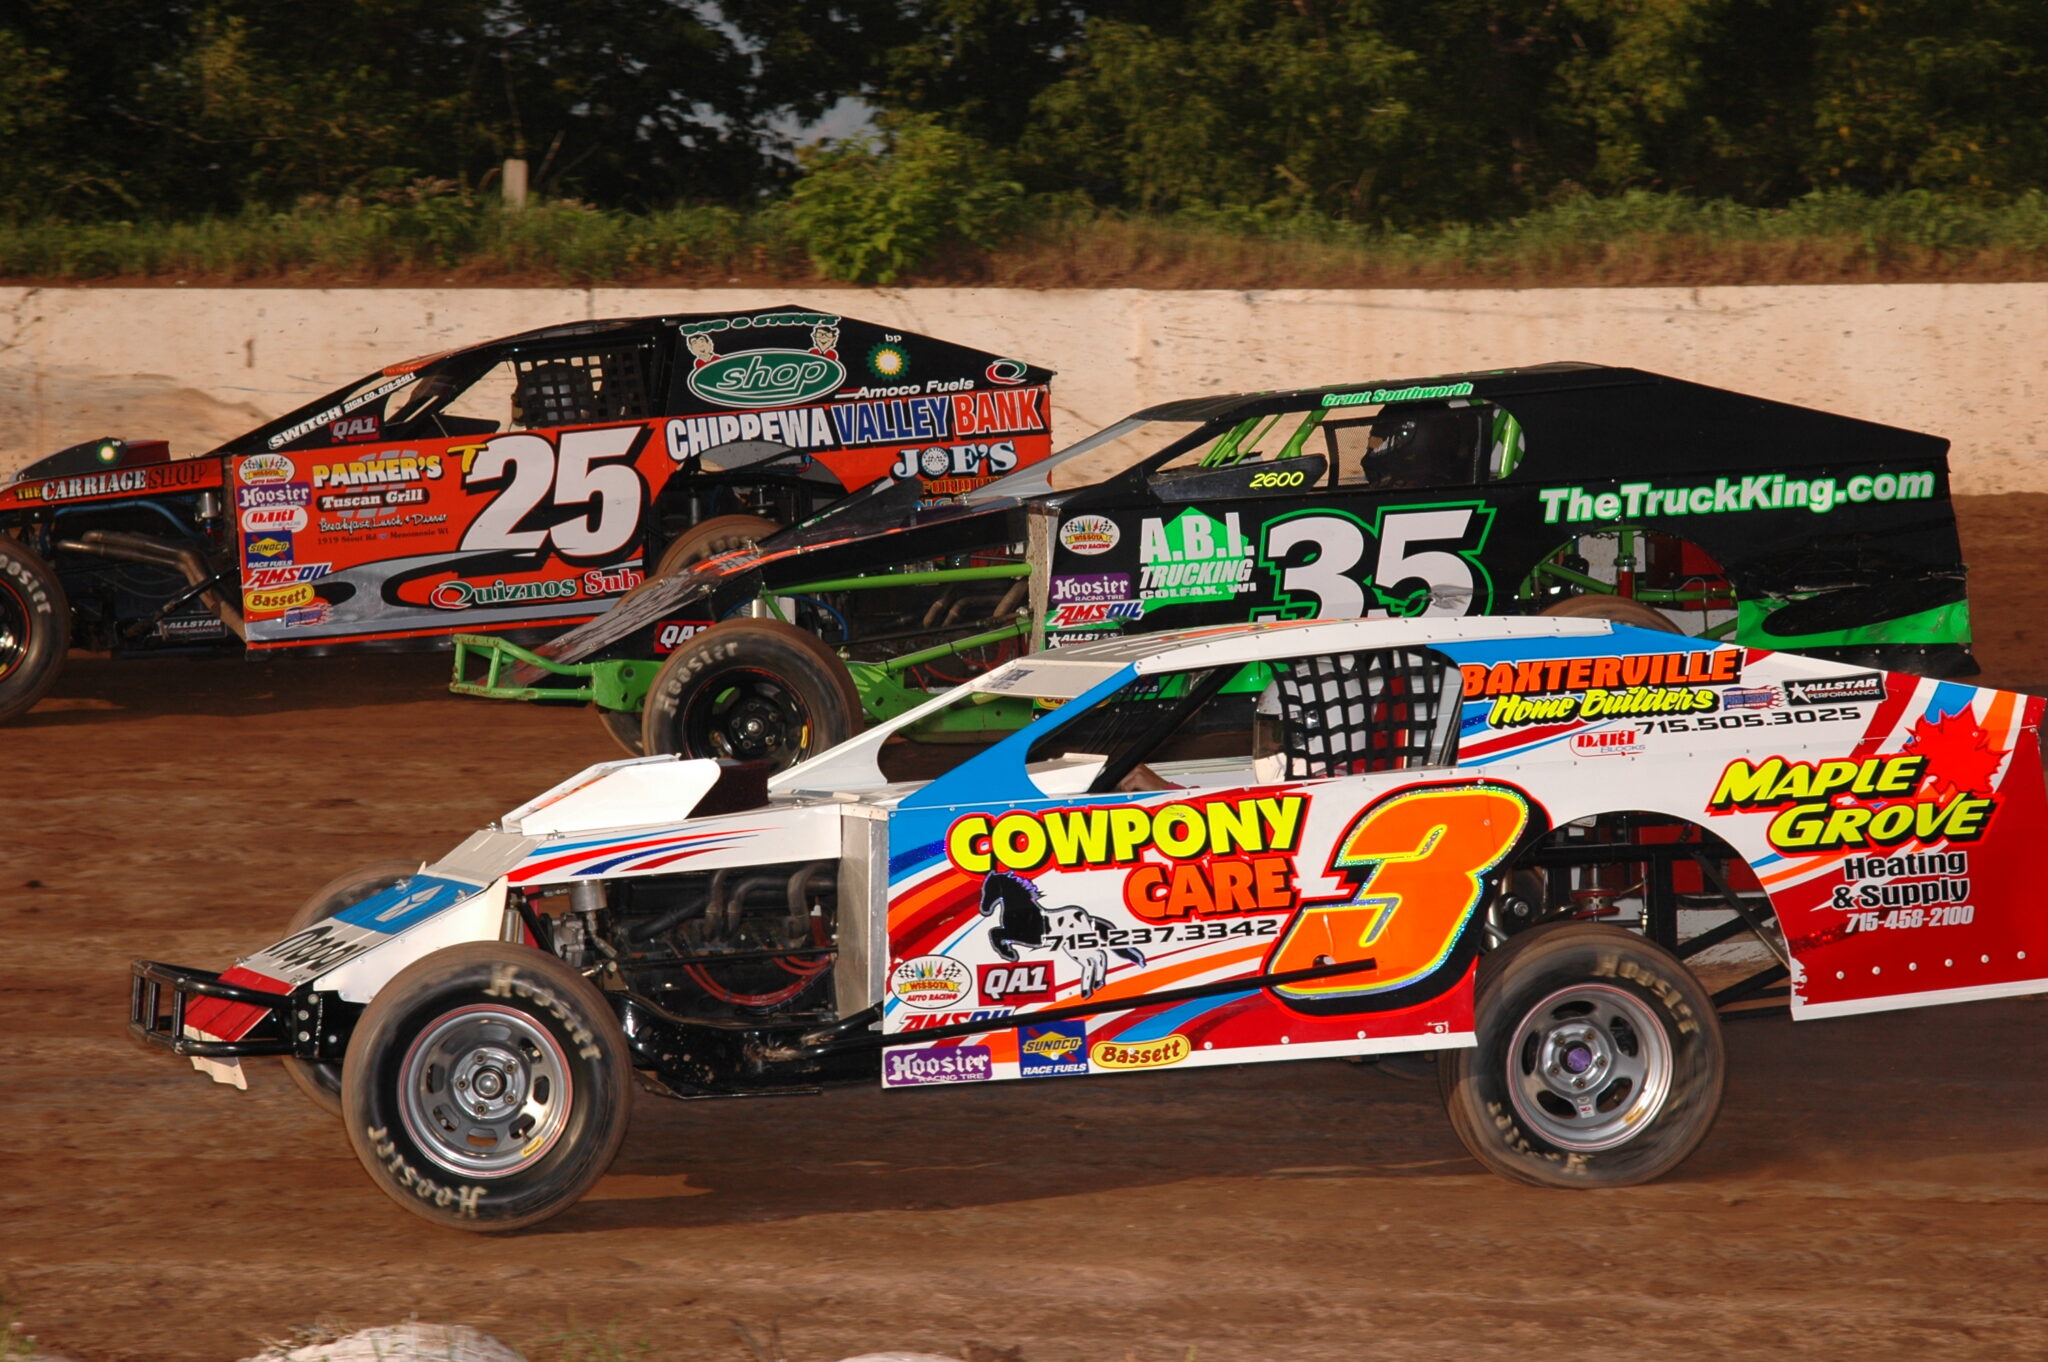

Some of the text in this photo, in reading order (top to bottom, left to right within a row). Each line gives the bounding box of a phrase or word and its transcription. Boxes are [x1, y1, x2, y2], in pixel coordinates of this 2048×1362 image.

[885, 333, 902, 343] bp
[716, 356, 828, 398] shop
[856, 378, 975, 400] Amoco Fuels
[1321, 390, 1370, 407] Grant
[268, 405, 344, 450] SWITCH
[332, 416, 377, 440] QA1
[666, 388, 1044, 462] CHIPPEWA VALLEY BANK
[313, 456, 444, 488] PARKER'S
[893, 440, 1018, 478] JOE'S
[16, 463, 208, 501] THE CARRIAGE SHOP
[460, 425, 643, 557] 25
[1249, 472, 1304, 488] 2600
[239, 484, 309, 507] Hoosier
[322, 488, 423, 510] Tuscan Grill
[1539, 471, 1935, 524] TheTruckKing.com
[249, 542, 290, 553] SUNOCO
[1139, 512, 1255, 564] A.B.I.
[246, 563, 332, 589] AMSOIL
[247, 561, 269, 569] RACE
[1139, 559, 1254, 589] TRUCKING
[1257, 509, 1474, 623] 35
[251, 588, 308, 607] Bassett
[430, 579, 577, 610] Quiznos
[1052, 575, 1129, 601] Hoosier
[1227, 582, 1257, 594] WI
[1052, 602, 1142, 626] AMSOIL
[1460, 650, 1738, 698] BAXTERVILLE
[1804, 678, 1880, 692] ALLSTAR
[1489, 694, 1577, 726] Home
[1578, 686, 1715, 719] Builders
[1807, 688, 1881, 699] PERFORMANCE
[1634, 707, 1862, 735] 715.505.3025
[1577, 730, 1638, 748] DART
[1711, 755, 1923, 804] MAPLE
[1769, 792, 1995, 848] GROVE
[950, 796, 1302, 873] COWPONY
[1845, 851, 1968, 881] Heating
[1127, 858, 1295, 918] CARE
[1267, 784, 1529, 1000] 3
[1832, 877, 1970, 909] & Supply
[1845, 905, 1975, 933] 715-458-2100
[1048, 919, 1279, 951] 715.237.3342
[906, 993, 958, 1002] AUTO RACING
[909, 980, 949, 991] WISSOTA
[984, 966, 1048, 1001] QA1
[1024, 1038, 1081, 1053] SUNOCO
[1101, 1039, 1181, 1064] Bassett
[887, 1048, 990, 1081] Hoosier
[918, 1072, 985, 1082] RACING TIRE
[1022, 1063, 1088, 1076] RACE FUELS
